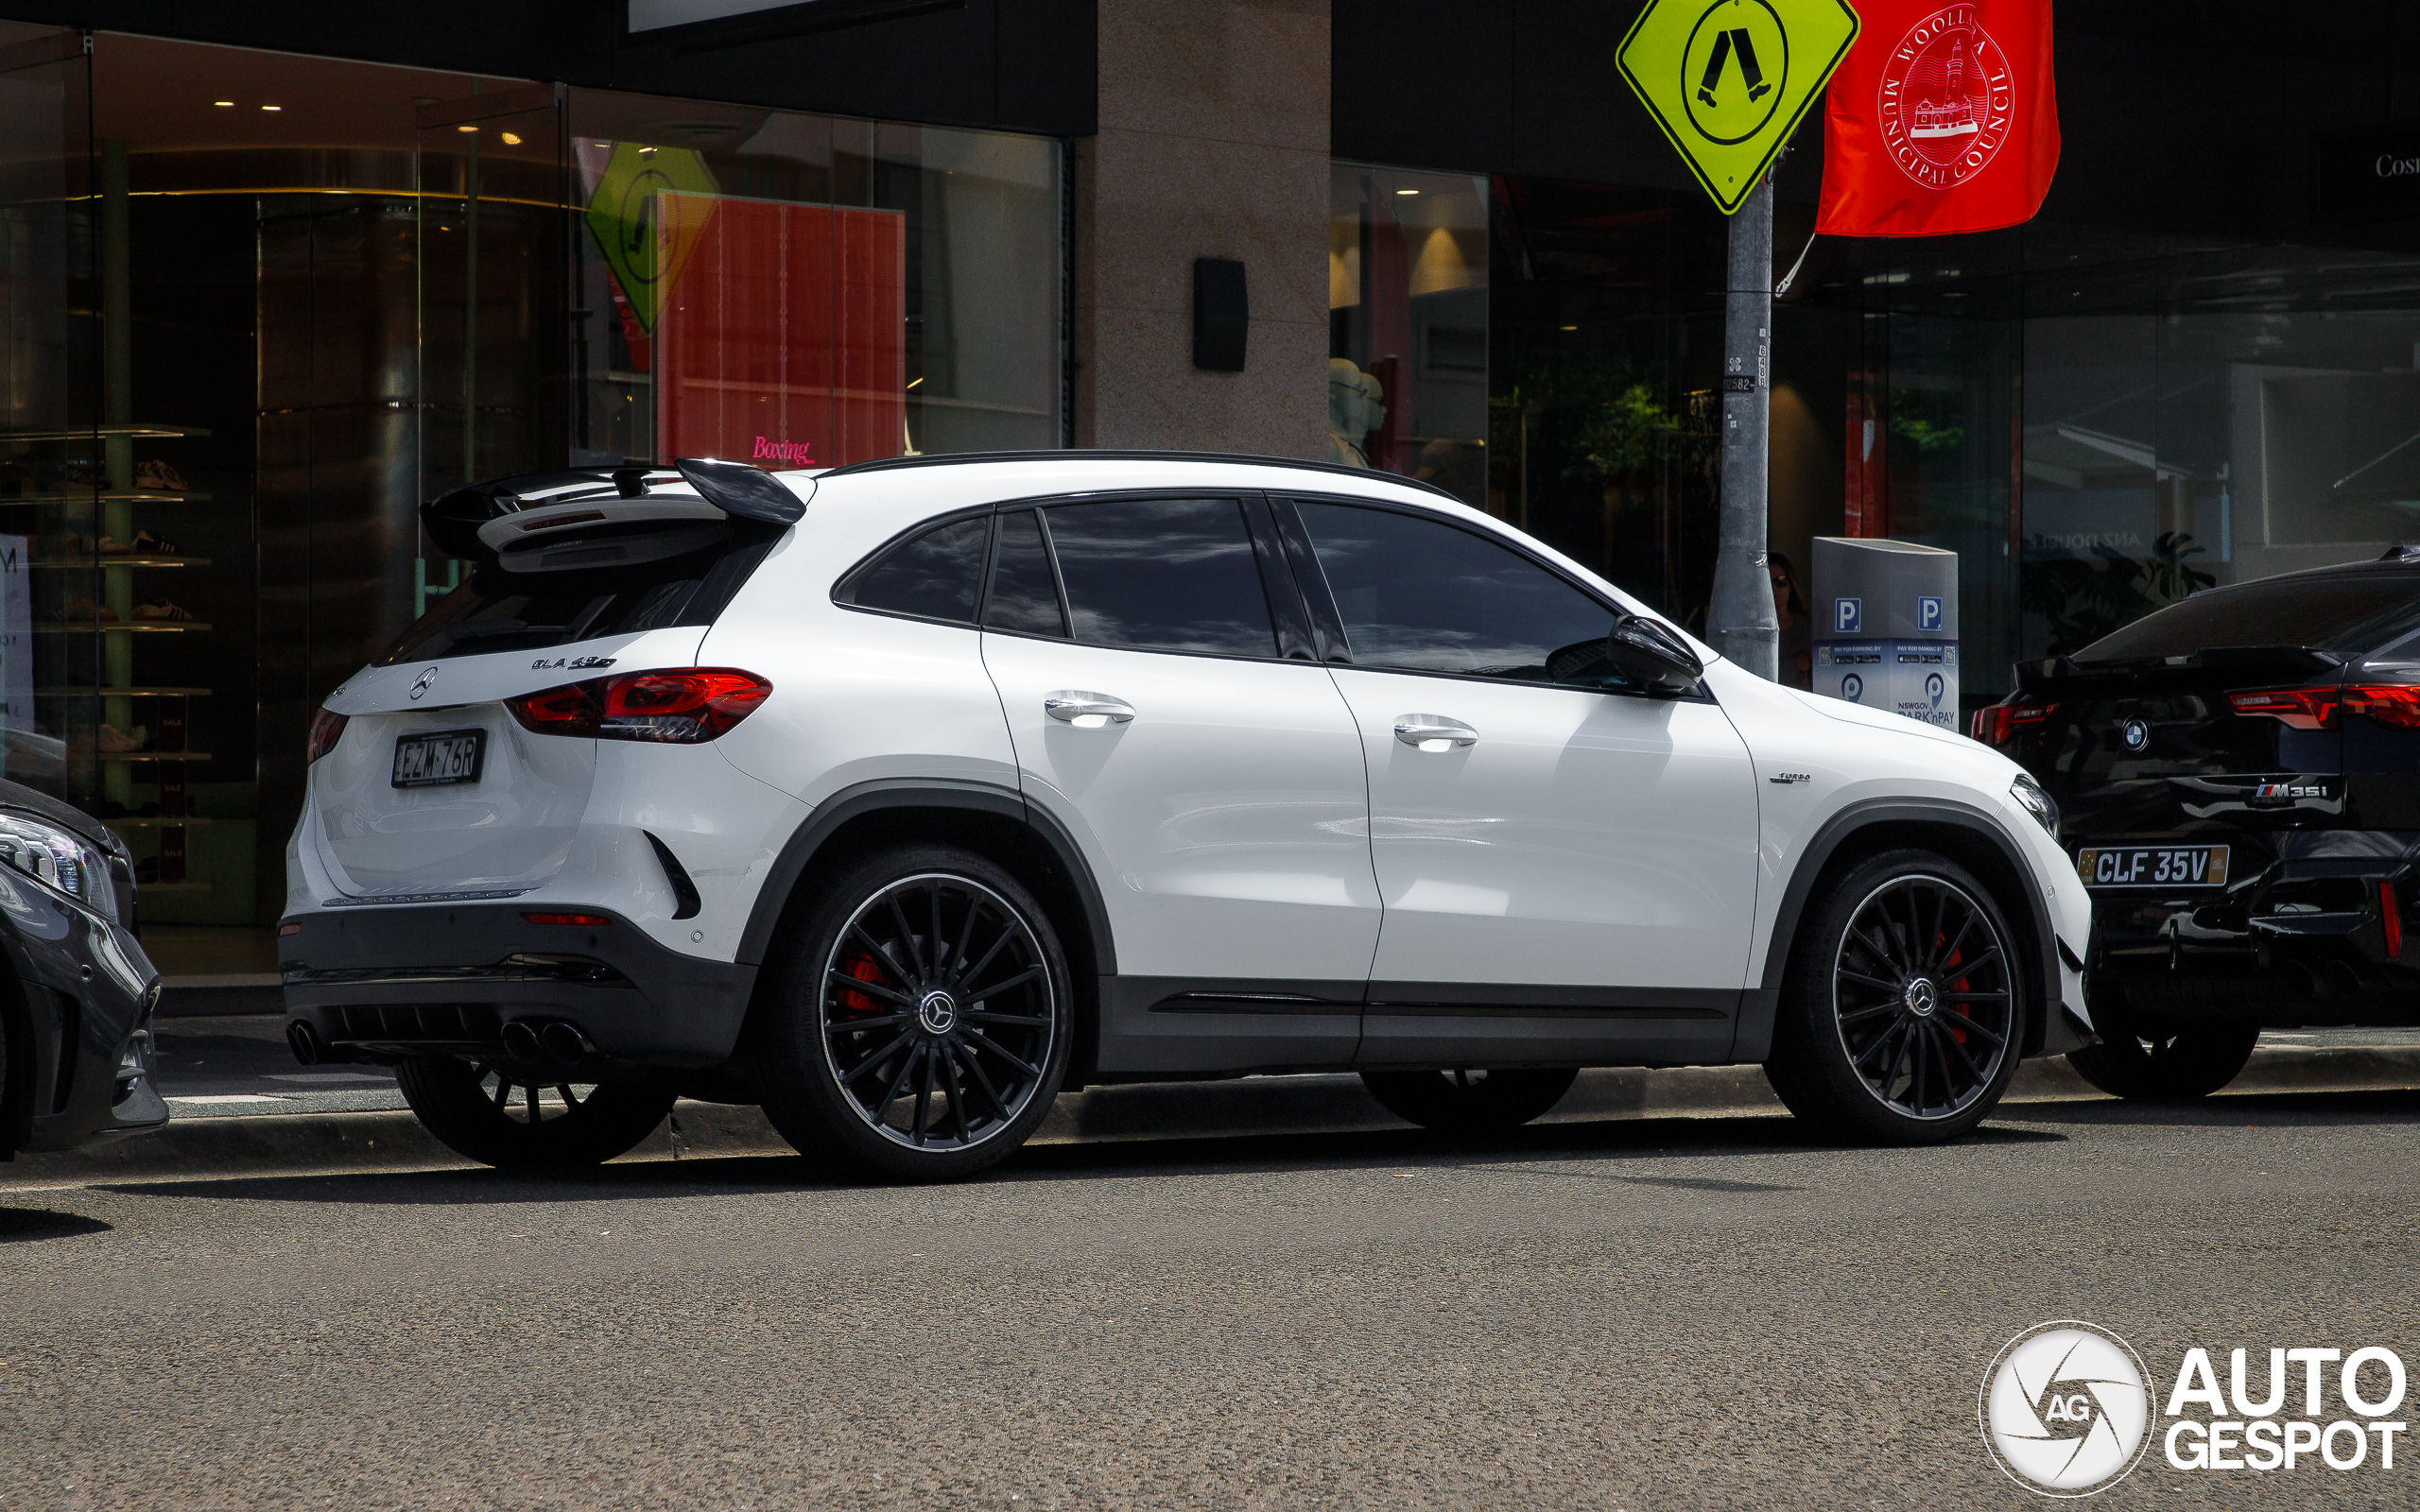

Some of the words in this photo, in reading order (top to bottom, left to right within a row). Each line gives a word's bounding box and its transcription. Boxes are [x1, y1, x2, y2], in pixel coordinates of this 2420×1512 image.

[1882, 78, 1946, 184] MUNICIPAL
[1954, 67, 2009, 179] COUNCIL
[752, 436, 810, 466] Boxing
[1840, 601, 1856, 629] P
[1923, 598, 1939, 627] P
[531, 658, 567, 670] GLA
[1898, 701, 1929, 710] NSWGOV
[1778, 771, 1811, 781] TURBO
[2096, 851, 2149, 883] CLF
[2153, 850, 2208, 882] 35V
